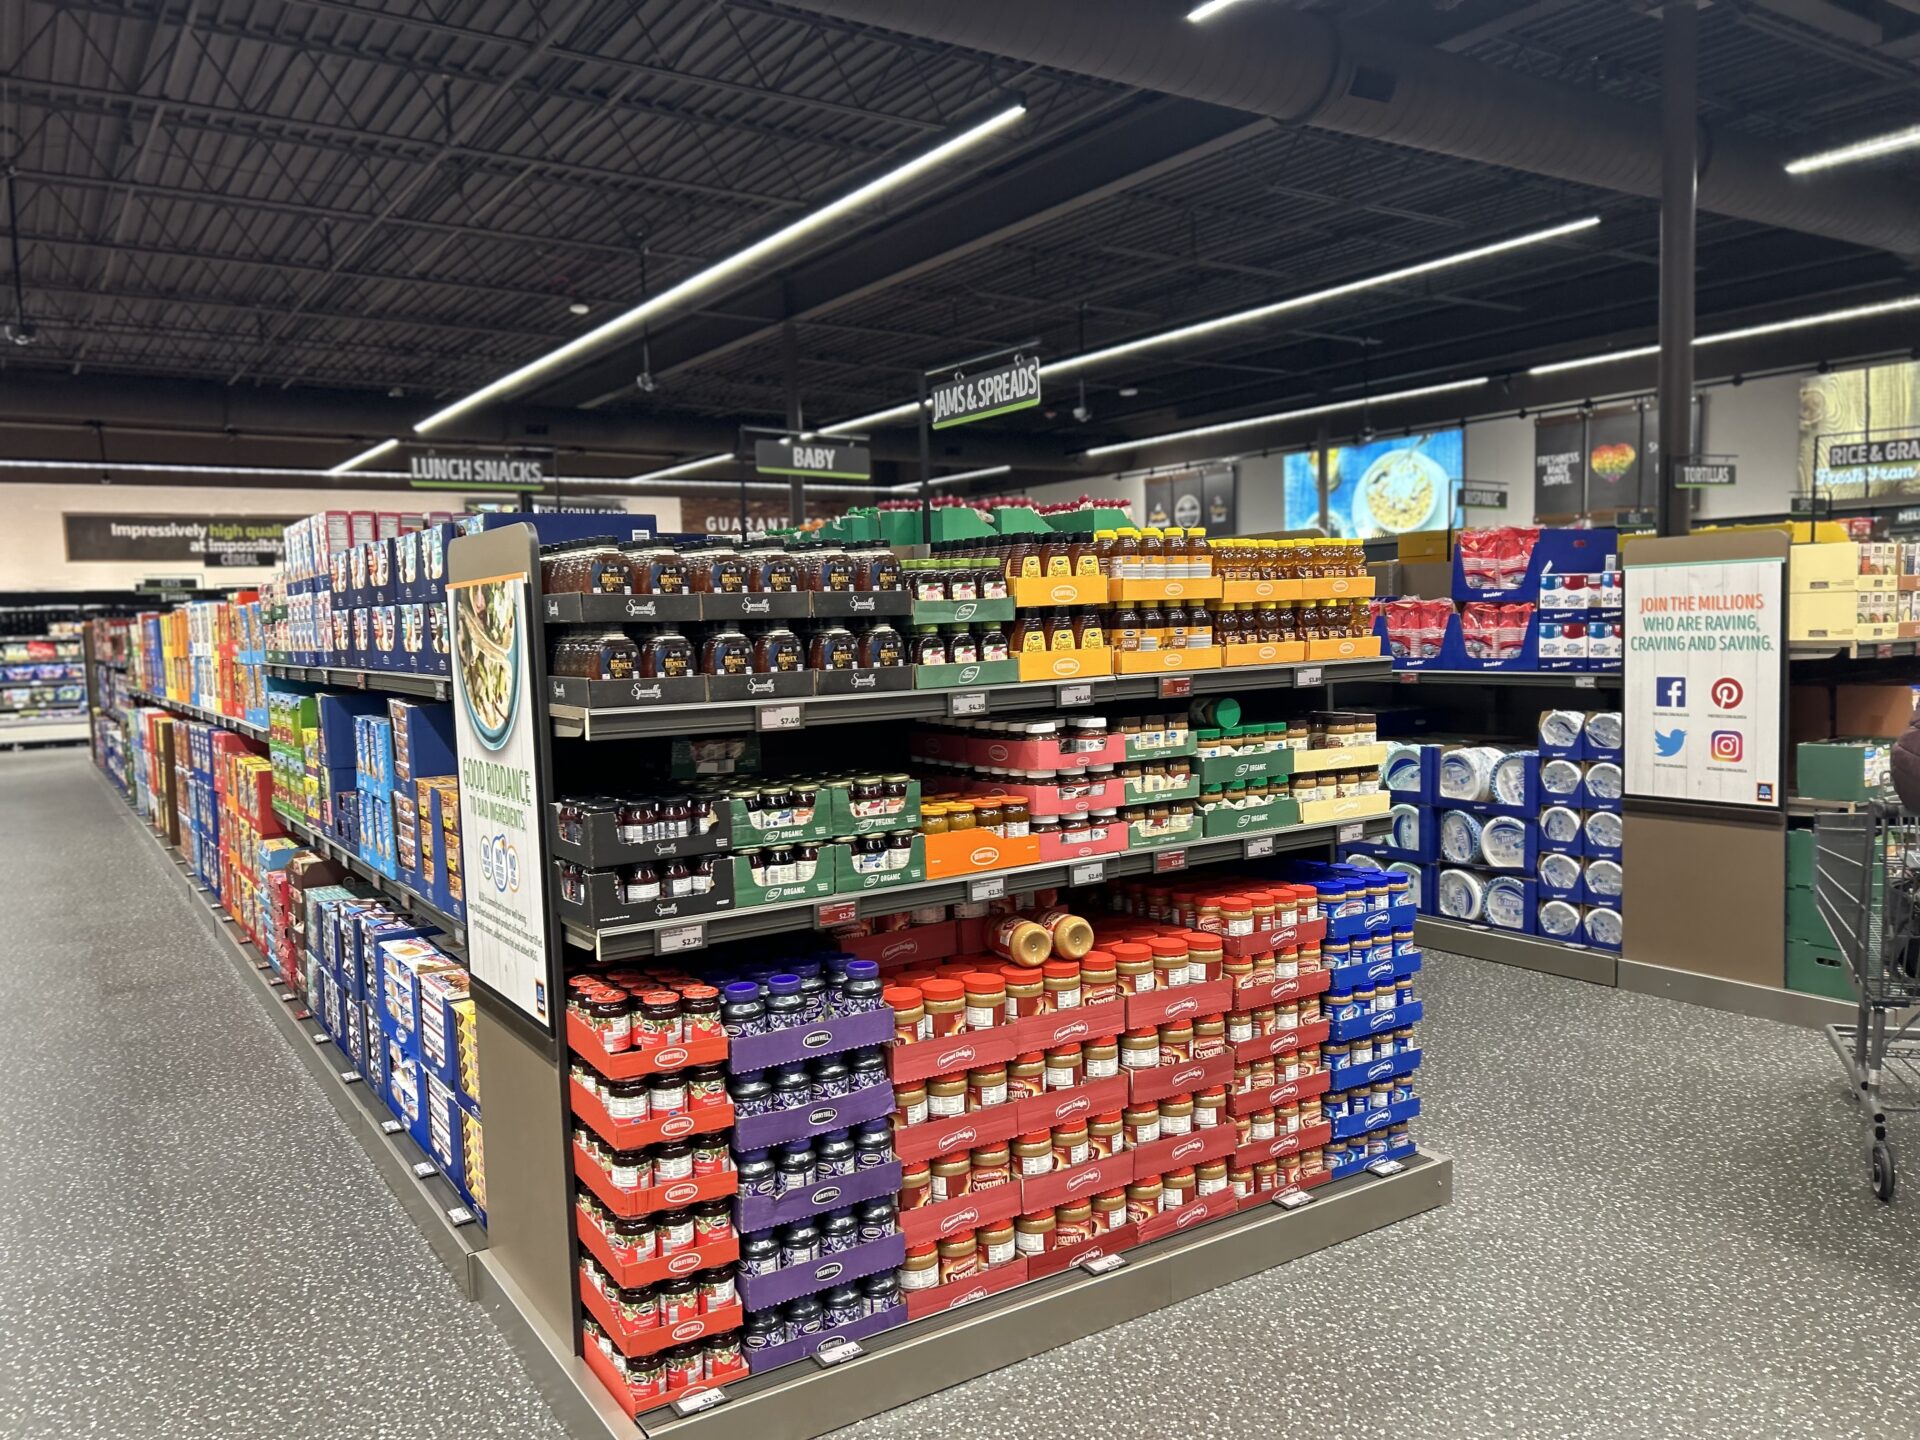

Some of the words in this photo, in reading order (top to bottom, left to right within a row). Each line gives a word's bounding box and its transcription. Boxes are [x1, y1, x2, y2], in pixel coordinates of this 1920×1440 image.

[933, 385, 965, 422] JAMS
[967, 386, 978, 410] &
[978, 364, 1037, 406] SPREADS
[793, 447, 835, 470] BABY
[1831, 445, 1868, 465] RICE
[1870, 445, 1883, 462] &
[411, 457, 472, 481] LUNCH
[473, 460, 543, 482] SNACKS
[1683, 465, 1730, 483] TORTILLAS
[111, 523, 207, 540] Impressively
[209, 524, 244, 539] high
[190, 541, 206, 553] at
[220, 553, 260, 566] CEREAL
[1640, 597, 1667, 614] JOIN
[1670, 596, 1696, 612] THE
[1699, 594, 1764, 611] MILLIONS
[1643, 616, 1674, 632] WHO
[1677, 616, 1701, 631] ARE
[1705, 615, 1760, 633] RAVING,
[1631, 636, 1685, 651] CRAVING
[1689, 636, 1716, 651] AND
[1719, 635, 1774, 651] SAVING.
[780, 717, 800, 726] $7.49
[1249, 763, 1266, 771] ORGANIC
[463, 757, 484, 793] GOOD
[486, 762, 531, 806] RIDDANCE
[469, 795, 476, 815] TO
[477, 798, 488, 819] BAD
[875, 818, 897, 826] ORGANIC
[781, 830, 803, 838] ORGANIC
[880, 873, 901, 881] ORGANIC
[783, 887, 805, 895] ORGANIC
[682, 937, 702, 946] $2.79
[1167, 1005, 1181, 1014] Peanut
[1181, 1000, 1194, 1009] Delight
[1056, 1029, 1070, 1039] Peanut
[1070, 1024, 1086, 1034] Delight
[806, 1034, 830, 1044] BERRYHILL
[658, 1052, 684, 1062] BERRYHILL
[941, 1055, 955, 1065] Peanut
[955, 1049, 973, 1060] Delight
[1195, 1046, 1223, 1059] Creamy
[1174, 1074, 1188, 1083] Peanut
[1058, 1107, 1072, 1117] Peanut
[1072, 1100, 1087, 1111] Delight
[811, 1110, 834, 1122] BERRYHILL
[665, 1121, 690, 1132] BERRYHILL
[941, 1137, 957, 1148] Peanut
[957, 1130, 974, 1141] Delight
[1174, 1147, 1188, 1156] Peanut
[1188, 1142, 1201, 1150] Delight
[973, 1178, 1006, 1192] Creamy
[1069, 1178, 1082, 1189] Peanut
[1082, 1172, 1099, 1182] Delight
[669, 1187, 695, 1198] BERRYHILL
[815, 1190, 838, 1202] BERRYHILL
[943, 1218, 958, 1228] Peanut
[958, 1211, 976, 1223] Delight
[1179, 1214, 1191, 1223] Peanut
[1191, 1207, 1204, 1216] Delight
[1057, 1234, 1081, 1244] eamy
[672, 1256, 698, 1269] BERRYHILL
[1071, 1256, 1086, 1267] Peanut
[1086, 1249, 1102, 1260] Delight
[817, 1266, 839, 1278] BERRYHILL
[676, 1324, 701, 1336] BERRYHILL
